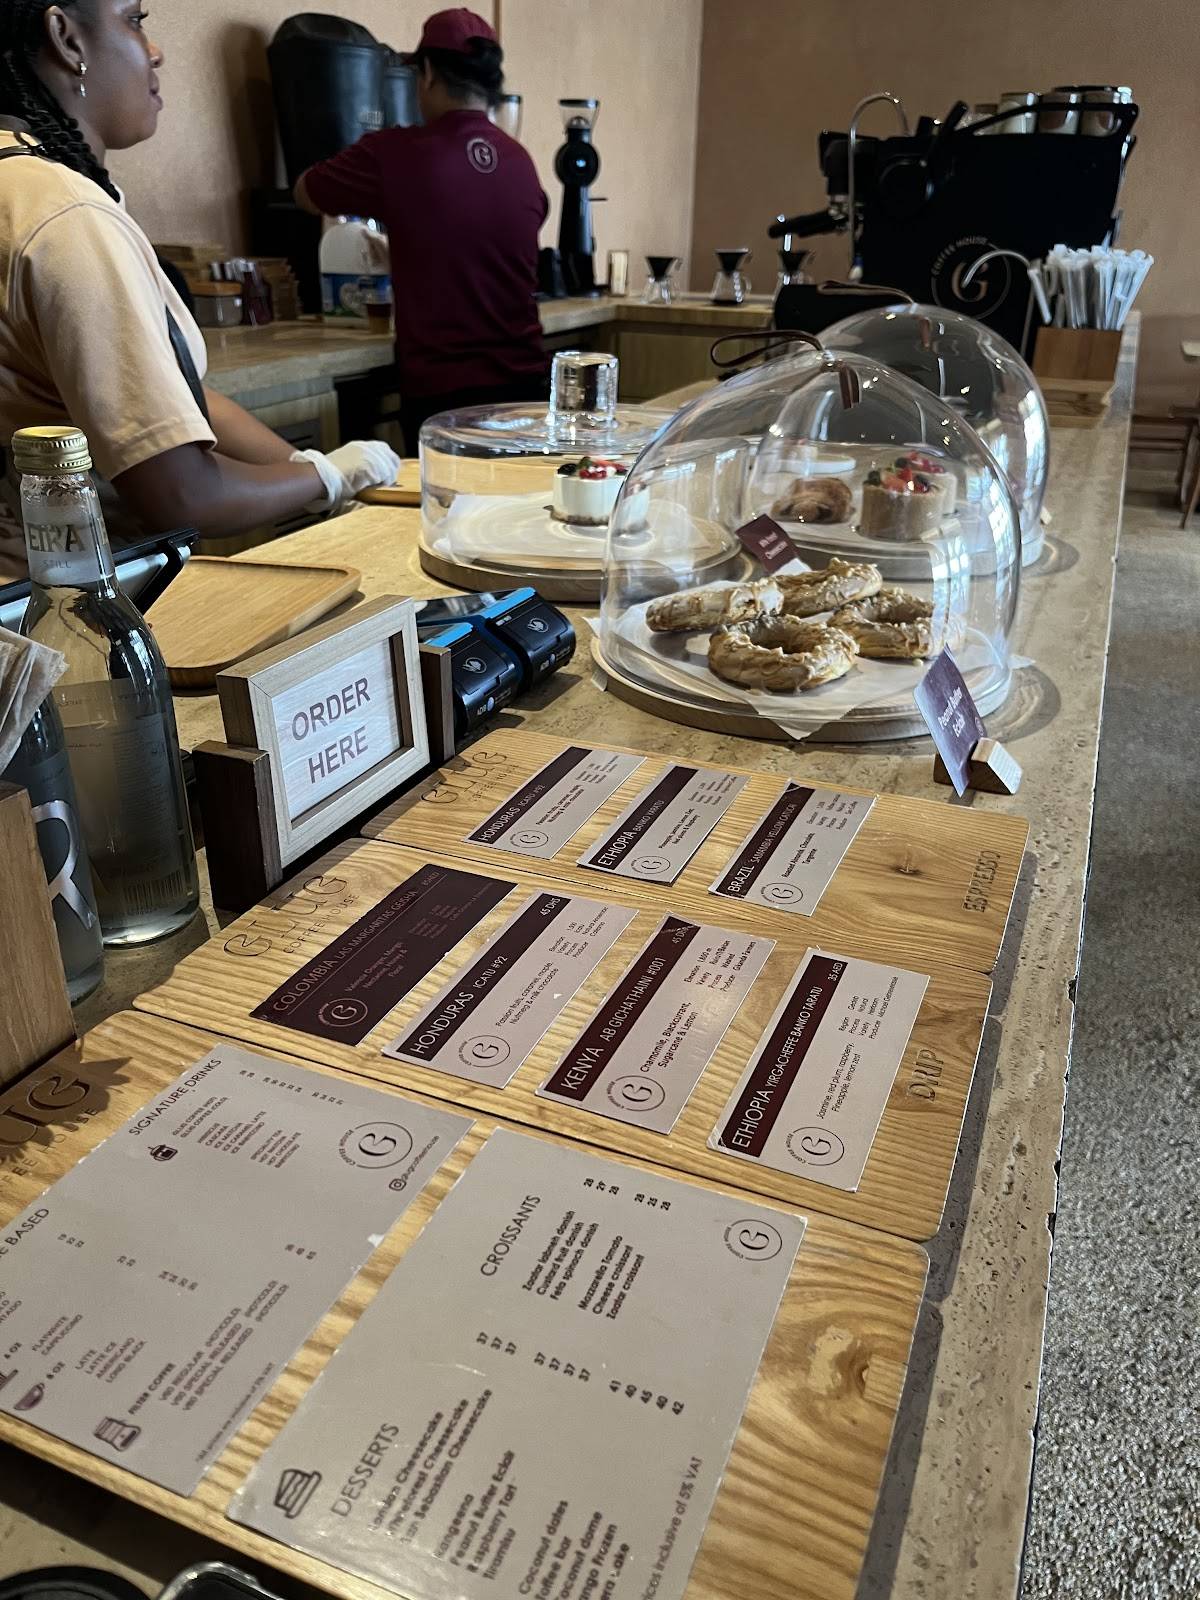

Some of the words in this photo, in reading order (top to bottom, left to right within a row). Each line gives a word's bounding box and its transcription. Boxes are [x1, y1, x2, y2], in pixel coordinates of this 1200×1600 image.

[291, 677, 371, 741] ORDER
[308, 725, 369, 784] HERE
[421, 751, 508, 804] GLUG
[478, 807, 520, 841] HONDURAS
[598, 832, 637, 865] ETHIOPIA
[728, 866, 754, 892] BRAZIL
[963, 849, 1001, 913] ESPRESSO
[224, 875, 348, 957] GLUG
[282, 919, 326, 954] COFFEE
[321, 893, 361, 922] HOUSE
[273, 961, 338, 1010] COLOMBIA
[348, 911, 395, 946] MARGARITAS
[410, 992, 473, 1053] HONDURAS
[473, 969, 496, 988] ICATU
[491, 956, 508, 968] #92
[540, 908, 551, 916] 45
[496, 1009, 514, 1026] Passion
[510, 1005, 530, 1024] Nutmeg
[561, 1048, 604, 1089] KENYA
[600, 1028, 616, 1041] AB
[609, 976, 653, 1027] GICHATHAINI
[646, 958, 666, 975] #001
[640, 1039, 669, 1072] Chamomile,
[662, 1003, 691, 1037] Blackcurrant,
[658, 1037, 682, 1067] Sugarcane
[681, 1012, 698, 1030] Lemon
[839, 1017, 849, 1031] Region
[848, 1019, 860, 1034] Process
[472, 1043, 499, 1059] G
[732, 1091, 773, 1147] ETHIOPIA
[766, 1037, 799, 1087] YIRGACHEFFE
[790, 1012, 810, 1036] BANKO
[803, 987, 822, 1010] TARATU
[832, 963, 842, 974] AED
[907, 1049, 944, 1102] DRIP
[129, 1087, 188, 1135] SIGNATURE
[184, 1059, 221, 1087] DRINKS
[622, 1084, 652, 1102] G
[817, 1095, 833, 1119] Jasmine,
[828, 1083, 836, 1094] red
[839, 1043, 854, 1067] raspberry,
[832, 1083, 850, 1112] Pineapple,
[844, 1064, 856, 1081] lemon
[852, 1054, 860, 1064] zest
[36, 1107, 98, 1155] HOUSE
[339, 1148, 356, 1166] COFFEE
[359, 1133, 396, 1156] G
[802, 1136, 831, 1155] G
[4, 1209, 49, 1245] BASED
[480, 1196, 540, 1276] CROISSANTS
[522, 1264, 543, 1291] Zaatar
[538, 1236, 560, 1263] labneh
[557, 1211, 575, 1235] danish
[740, 1230, 769, 1250] G
[537, 1263, 560, 1295] Custard
[554, 1247, 569, 1262] fruit
[566, 1222, 584, 1246] danish
[550, 1282, 566, 1300] Feta
[563, 1249, 584, 1280] spinach
[581, 1223, 599, 1248] danish
[578, 1265, 607, 1310] Mozzarella
[601, 1236, 622, 1264] Tomato
[592, 1282, 615, 1314] Cheese
[611, 1245, 633, 1280] croissant
[606, 1291, 626, 1319] Zaatar
[623, 1254, 644, 1290] croissant
[32, 1316, 68, 1351] FLATWHITE
[75, 1350, 97, 1369] LATTE
[85, 1353, 107, 1374] LATTE
[104, 1342, 117, 1353] ICE
[96, 1338, 134, 1378] AMERICANO
[534, 1352, 545, 1365] 37
[128, 1392, 150, 1414] FILTER
[148, 1363, 175, 1391] COFFEE
[171, 1351, 204, 1386] REGULAR
[184, 1362, 212, 1391] SPECIAL
[195, 1366, 224, 1396] SPECIAL
[396, 1412, 443, 1483] Cheesecake
[476, 1332, 488, 1344] 37
[424, 1400, 468, 1469] Cheesecake
[491, 1337, 502, 1349] 37
[656, 1396, 668, 1409] 40
[672, 1401, 684, 1415] 42
[414, 1461, 453, 1519] Sebastian
[448, 1390, 492, 1458] Cheesecake
[505, 1342, 516, 1355] 37
[331, 1423, 399, 1517] DESSERTS
[450, 1520, 480, 1566] Peanut
[473, 1484, 497, 1519] Butter
[492, 1450, 514, 1482] Eclair
[549, 1358, 560, 1370] 37
[466, 1509, 507, 1573] Raspberry
[499, 1484, 517, 1506] Tart
[564, 1363, 575, 1376] 37
[482, 1528, 516, 1580] Tiramisu
[579, 1368, 590, 1381] 37
[519, 1537, 551, 1594] Coconut
[547, 1501, 568, 1535] dates
[610, 1381, 621, 1392] 41
[554, 1536, 572, 1559] bar
[625, 1385, 637, 1398] 40
[685, 1457, 702, 1478] VAT
[554, 1550, 586, 1599] oconut
[580, 1512, 602, 1549] dome
[640, 1390, 652, 1403] 45
[676, 1500, 687, 1515] of
[679, 1482, 694, 1499] 5%
[653, 1517, 681, 1571] inclusive
